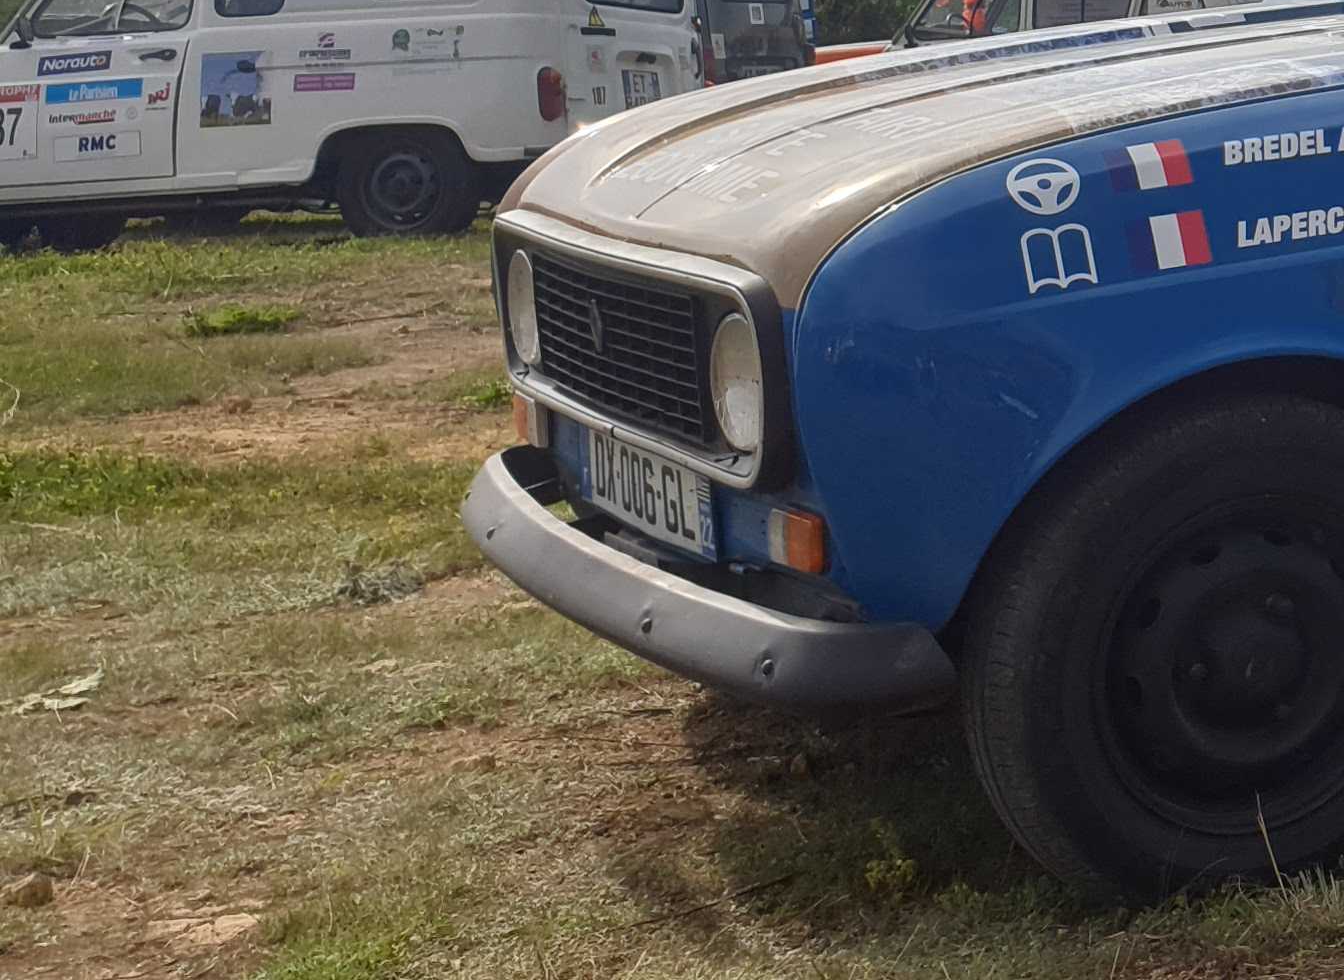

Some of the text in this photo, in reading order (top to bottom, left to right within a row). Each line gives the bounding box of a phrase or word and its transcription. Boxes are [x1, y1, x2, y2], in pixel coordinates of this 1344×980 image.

[42, 54, 107, 72] Norauto
[78, 135, 117, 153] RMC
[1224, 127, 1332, 166] BREDEL
[594, 433, 697, 542] DX-006-GL
